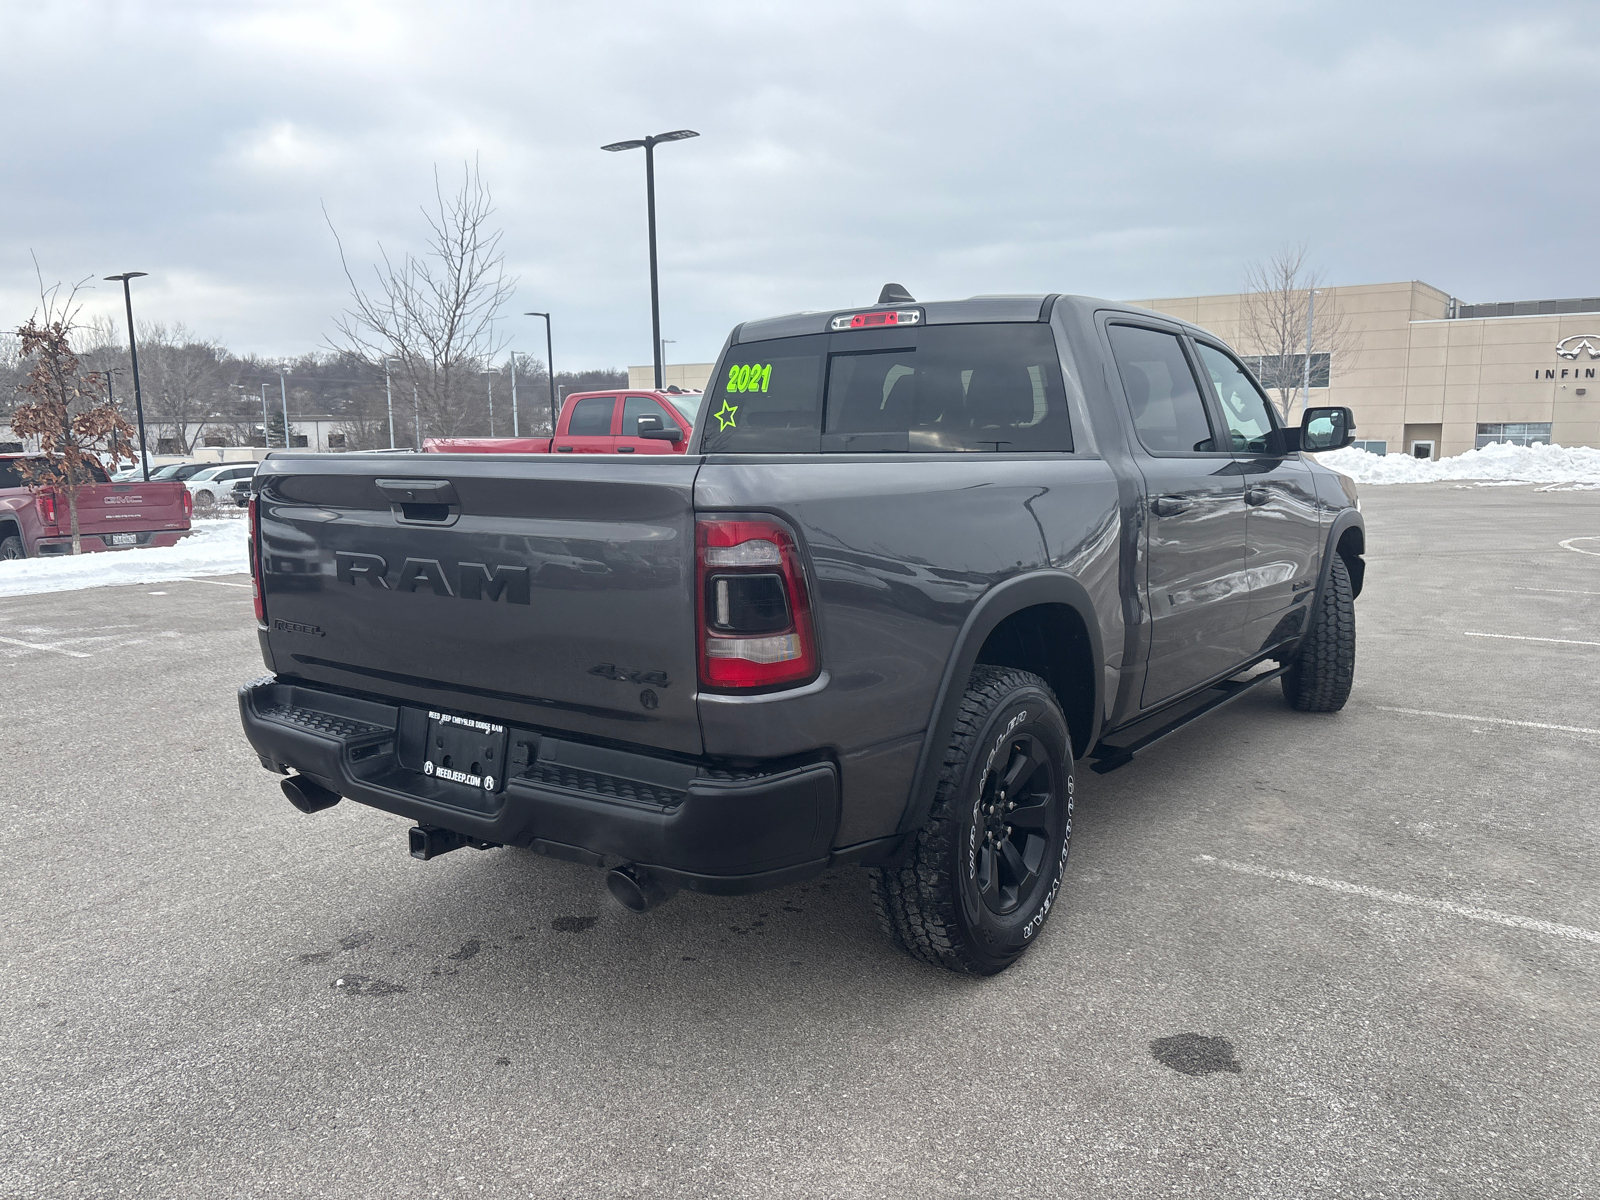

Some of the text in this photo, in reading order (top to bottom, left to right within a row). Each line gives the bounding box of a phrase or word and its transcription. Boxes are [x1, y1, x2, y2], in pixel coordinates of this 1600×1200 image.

[726, 363, 772, 393] 2021
[1535, 368, 1595, 379] INFIN
[103, 495, 142, 504] GMC
[335, 551, 530, 605] RAM
[274, 618, 326, 638] REBEL
[428, 711, 503, 733] REED JEEP CHRYSLER DODGE RAM
[435, 767, 481, 787] REEDJEEP.COM
[1023, 775, 1075, 939] GOODYEAR
